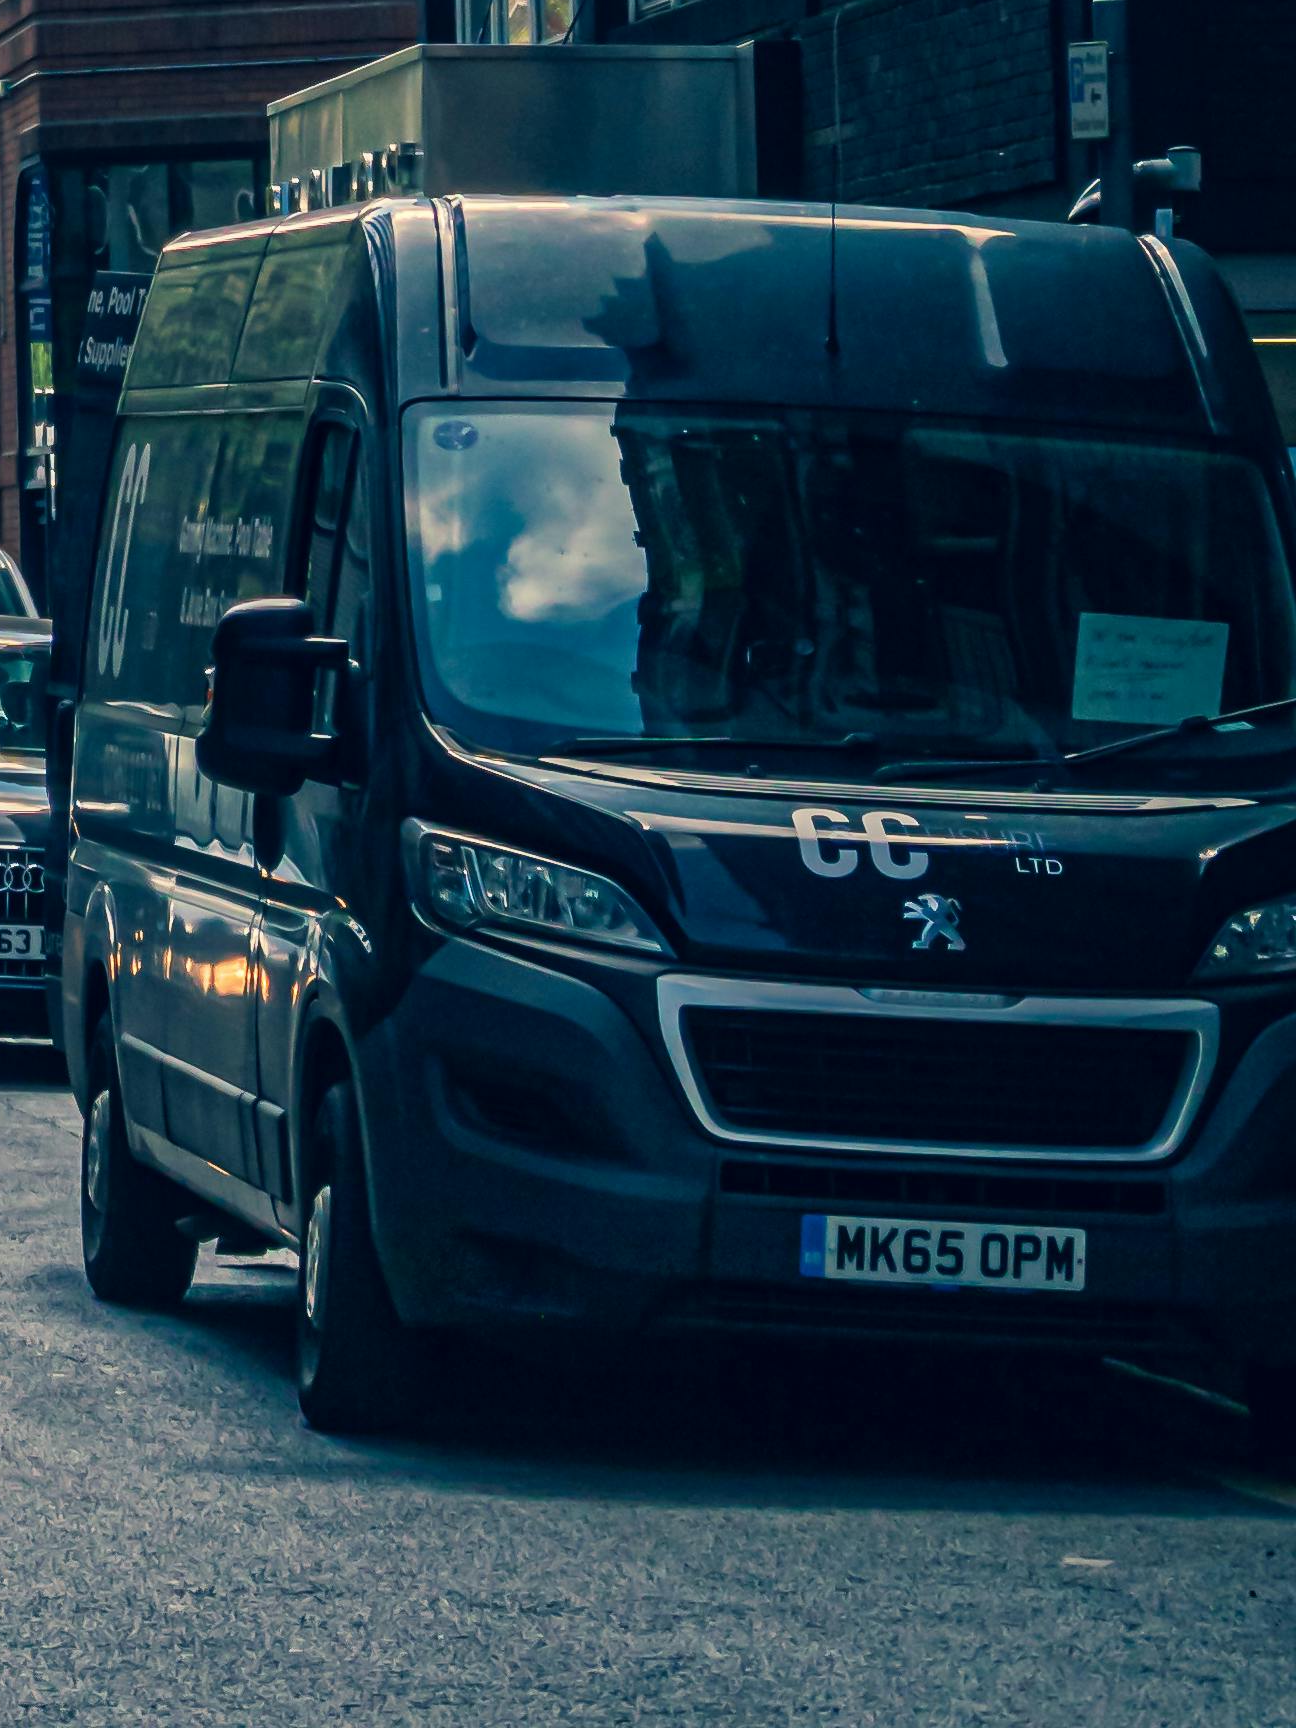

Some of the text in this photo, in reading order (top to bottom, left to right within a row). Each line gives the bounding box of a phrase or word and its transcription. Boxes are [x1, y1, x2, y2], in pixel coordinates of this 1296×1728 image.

[108, 286, 136, 315] Pool
[791, 808, 929, 879] CC
[1015, 857, 1064, 876] LTD
[836, 1225, 1075, 1281] MK65 OPM
